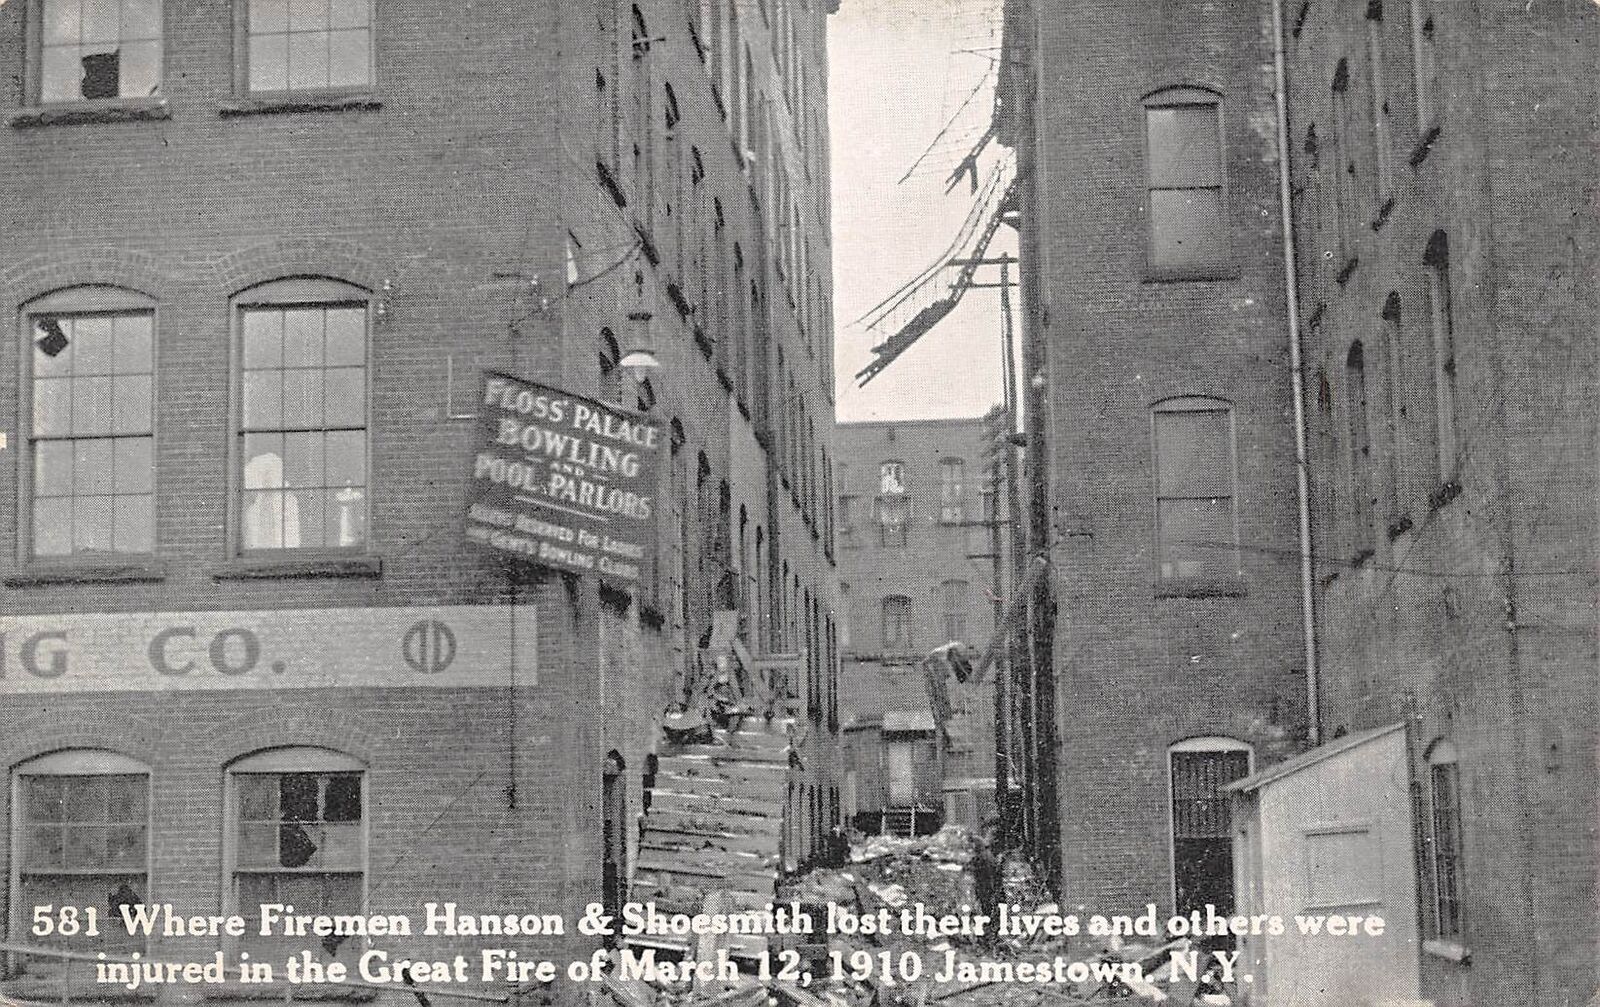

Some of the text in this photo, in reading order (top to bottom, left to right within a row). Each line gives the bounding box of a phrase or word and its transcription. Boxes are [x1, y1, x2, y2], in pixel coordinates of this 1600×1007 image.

[498, 418, 639, 477] BOWLING
[573, 403, 658, 447] PALACE
[475, 453, 537, 491] POOL
[550, 473, 649, 519] PARLORS
[550, 462, 585, 476] AND
[0, 626, 288, 679] G CO.
